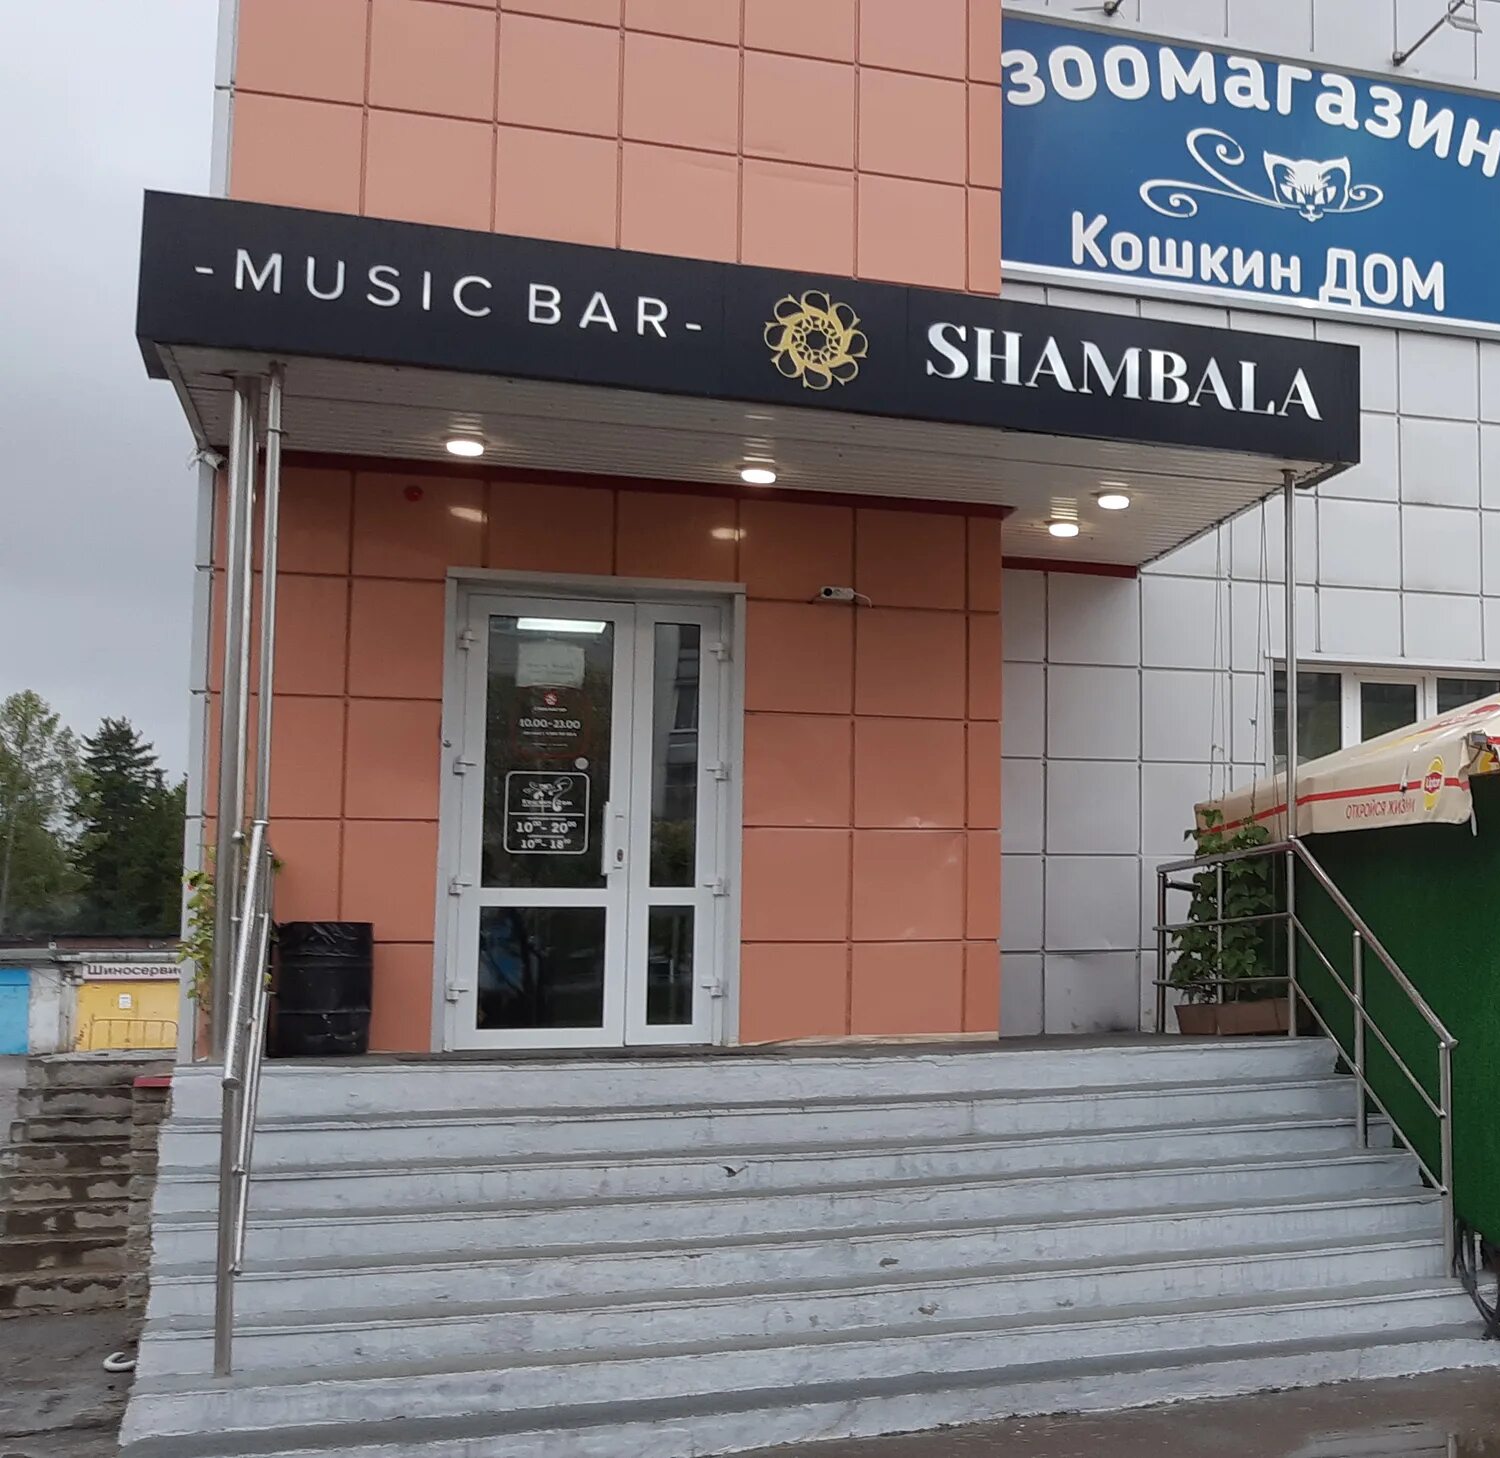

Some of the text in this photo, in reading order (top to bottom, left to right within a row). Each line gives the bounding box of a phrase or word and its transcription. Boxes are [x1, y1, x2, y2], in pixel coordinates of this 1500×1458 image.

[1071, 211, 1445, 311] Кошкин ДОМ
[925, 321, 1324, 421] SHAMBALA
[1346, 799, 1386, 819] ОТКРОЙСЯ
